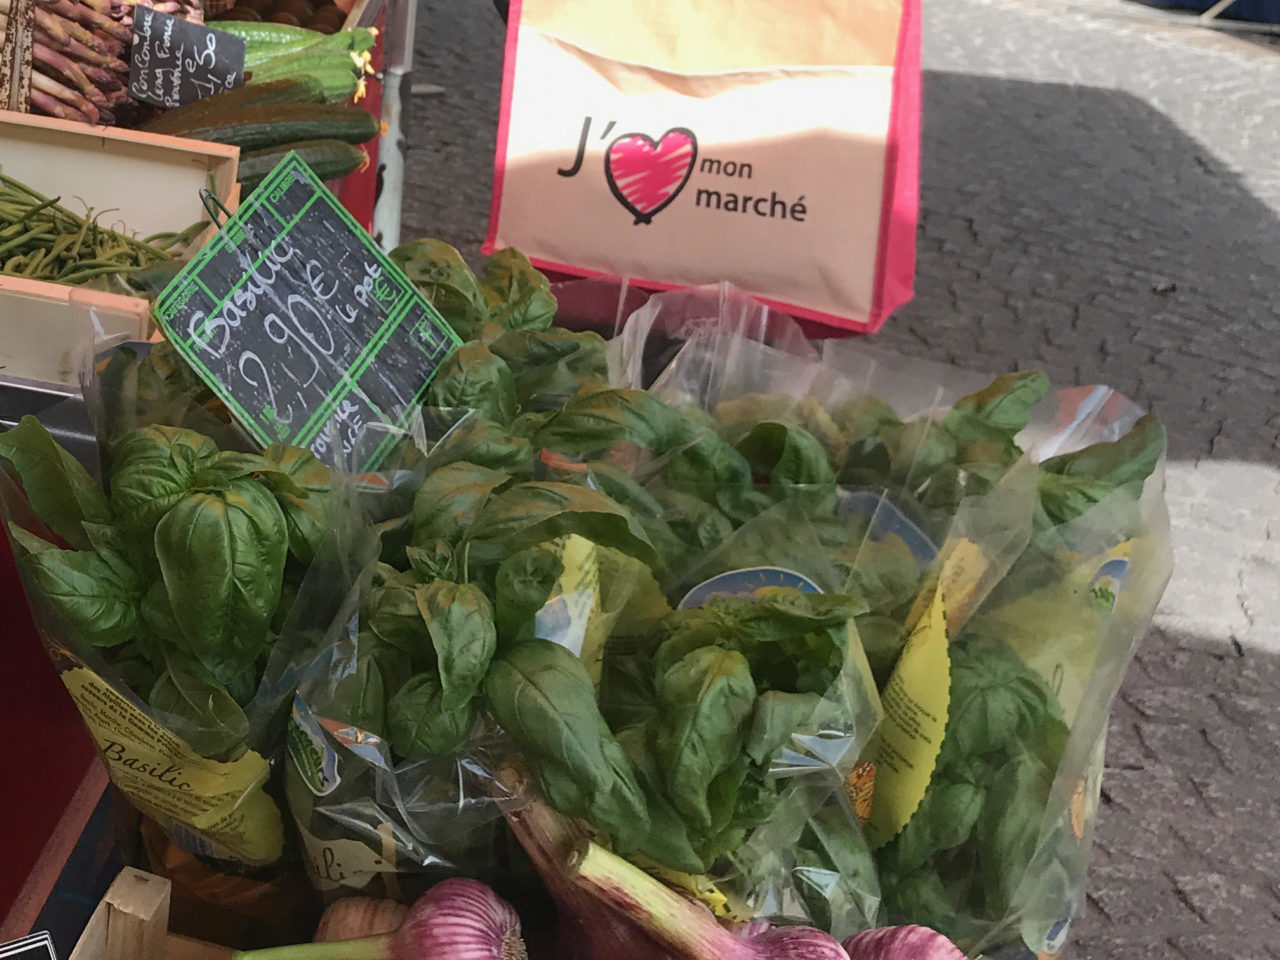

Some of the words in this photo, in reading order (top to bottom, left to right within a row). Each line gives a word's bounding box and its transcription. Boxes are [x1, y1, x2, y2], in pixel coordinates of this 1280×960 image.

[700, 157, 753, 180] mon
[695, 187, 808, 222] marché
[187, 240, 296, 359] Basilic
[354, 262, 382, 307] pot
[102, 738, 195, 792] Basilic
